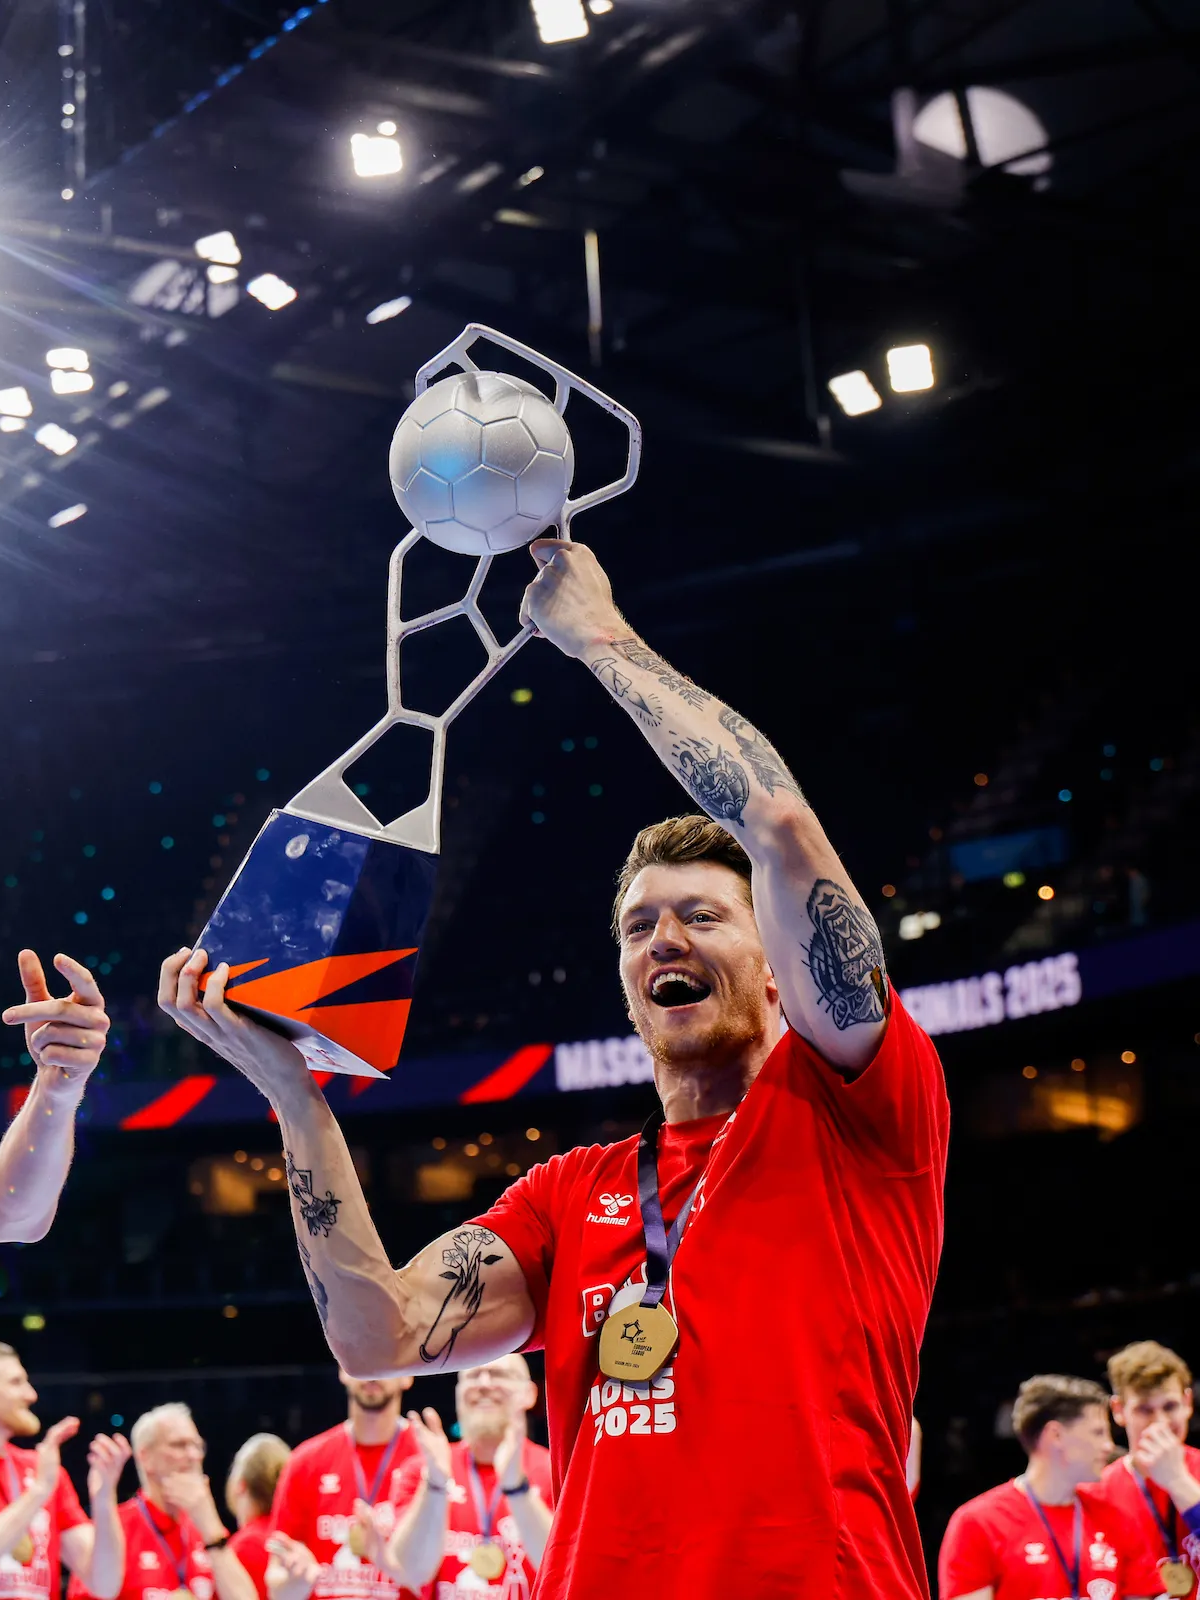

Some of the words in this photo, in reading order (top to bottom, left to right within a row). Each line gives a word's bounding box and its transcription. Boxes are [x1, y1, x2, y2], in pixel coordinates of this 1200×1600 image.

[1004, 951, 1082, 1020] 2025
[586, 1212, 630, 1226] hummel
[593, 1401, 677, 1447] 2025
